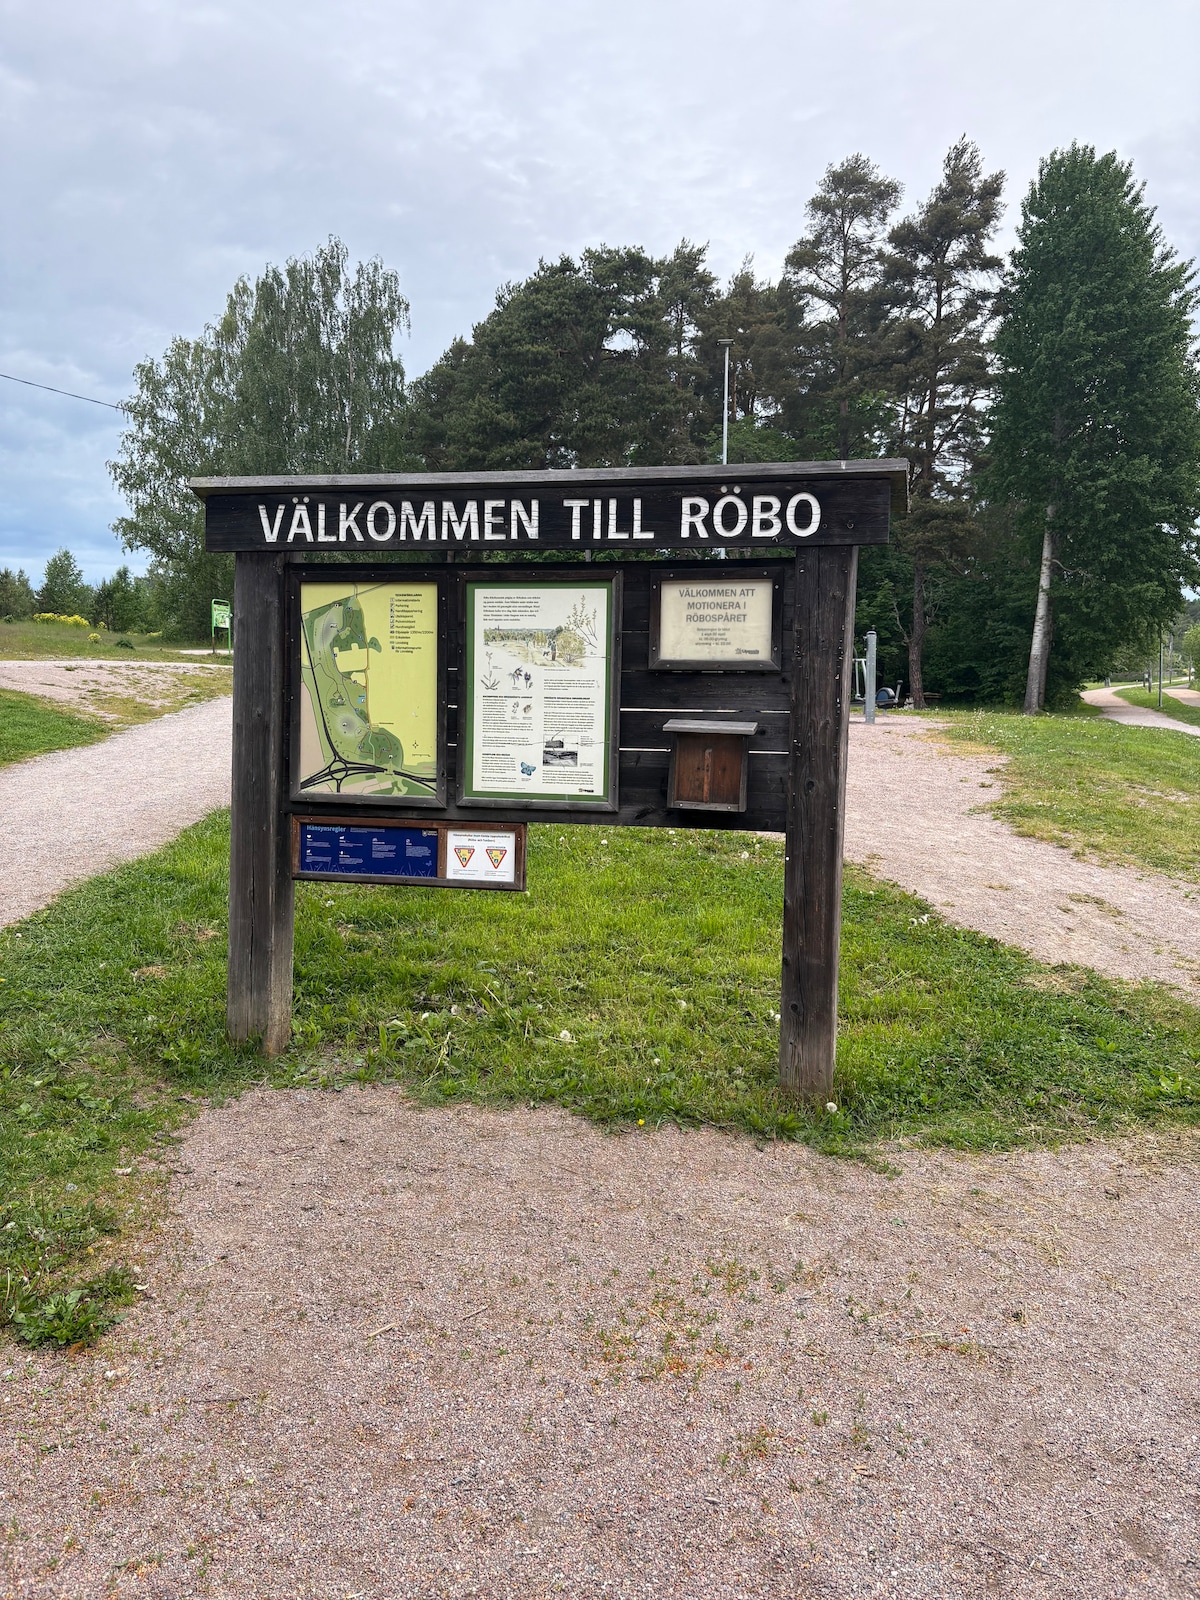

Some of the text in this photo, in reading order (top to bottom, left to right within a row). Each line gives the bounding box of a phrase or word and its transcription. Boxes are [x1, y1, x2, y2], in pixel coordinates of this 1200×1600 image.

[258, 485, 821, 542] VÄLKOMMEN TILL RÖBO
[679, 587, 756, 598] VÄLKOMMEN ATT
[687, 601, 746, 610] MOTIONERA I
[686, 612, 747, 622] RÖBOSPÅRET
